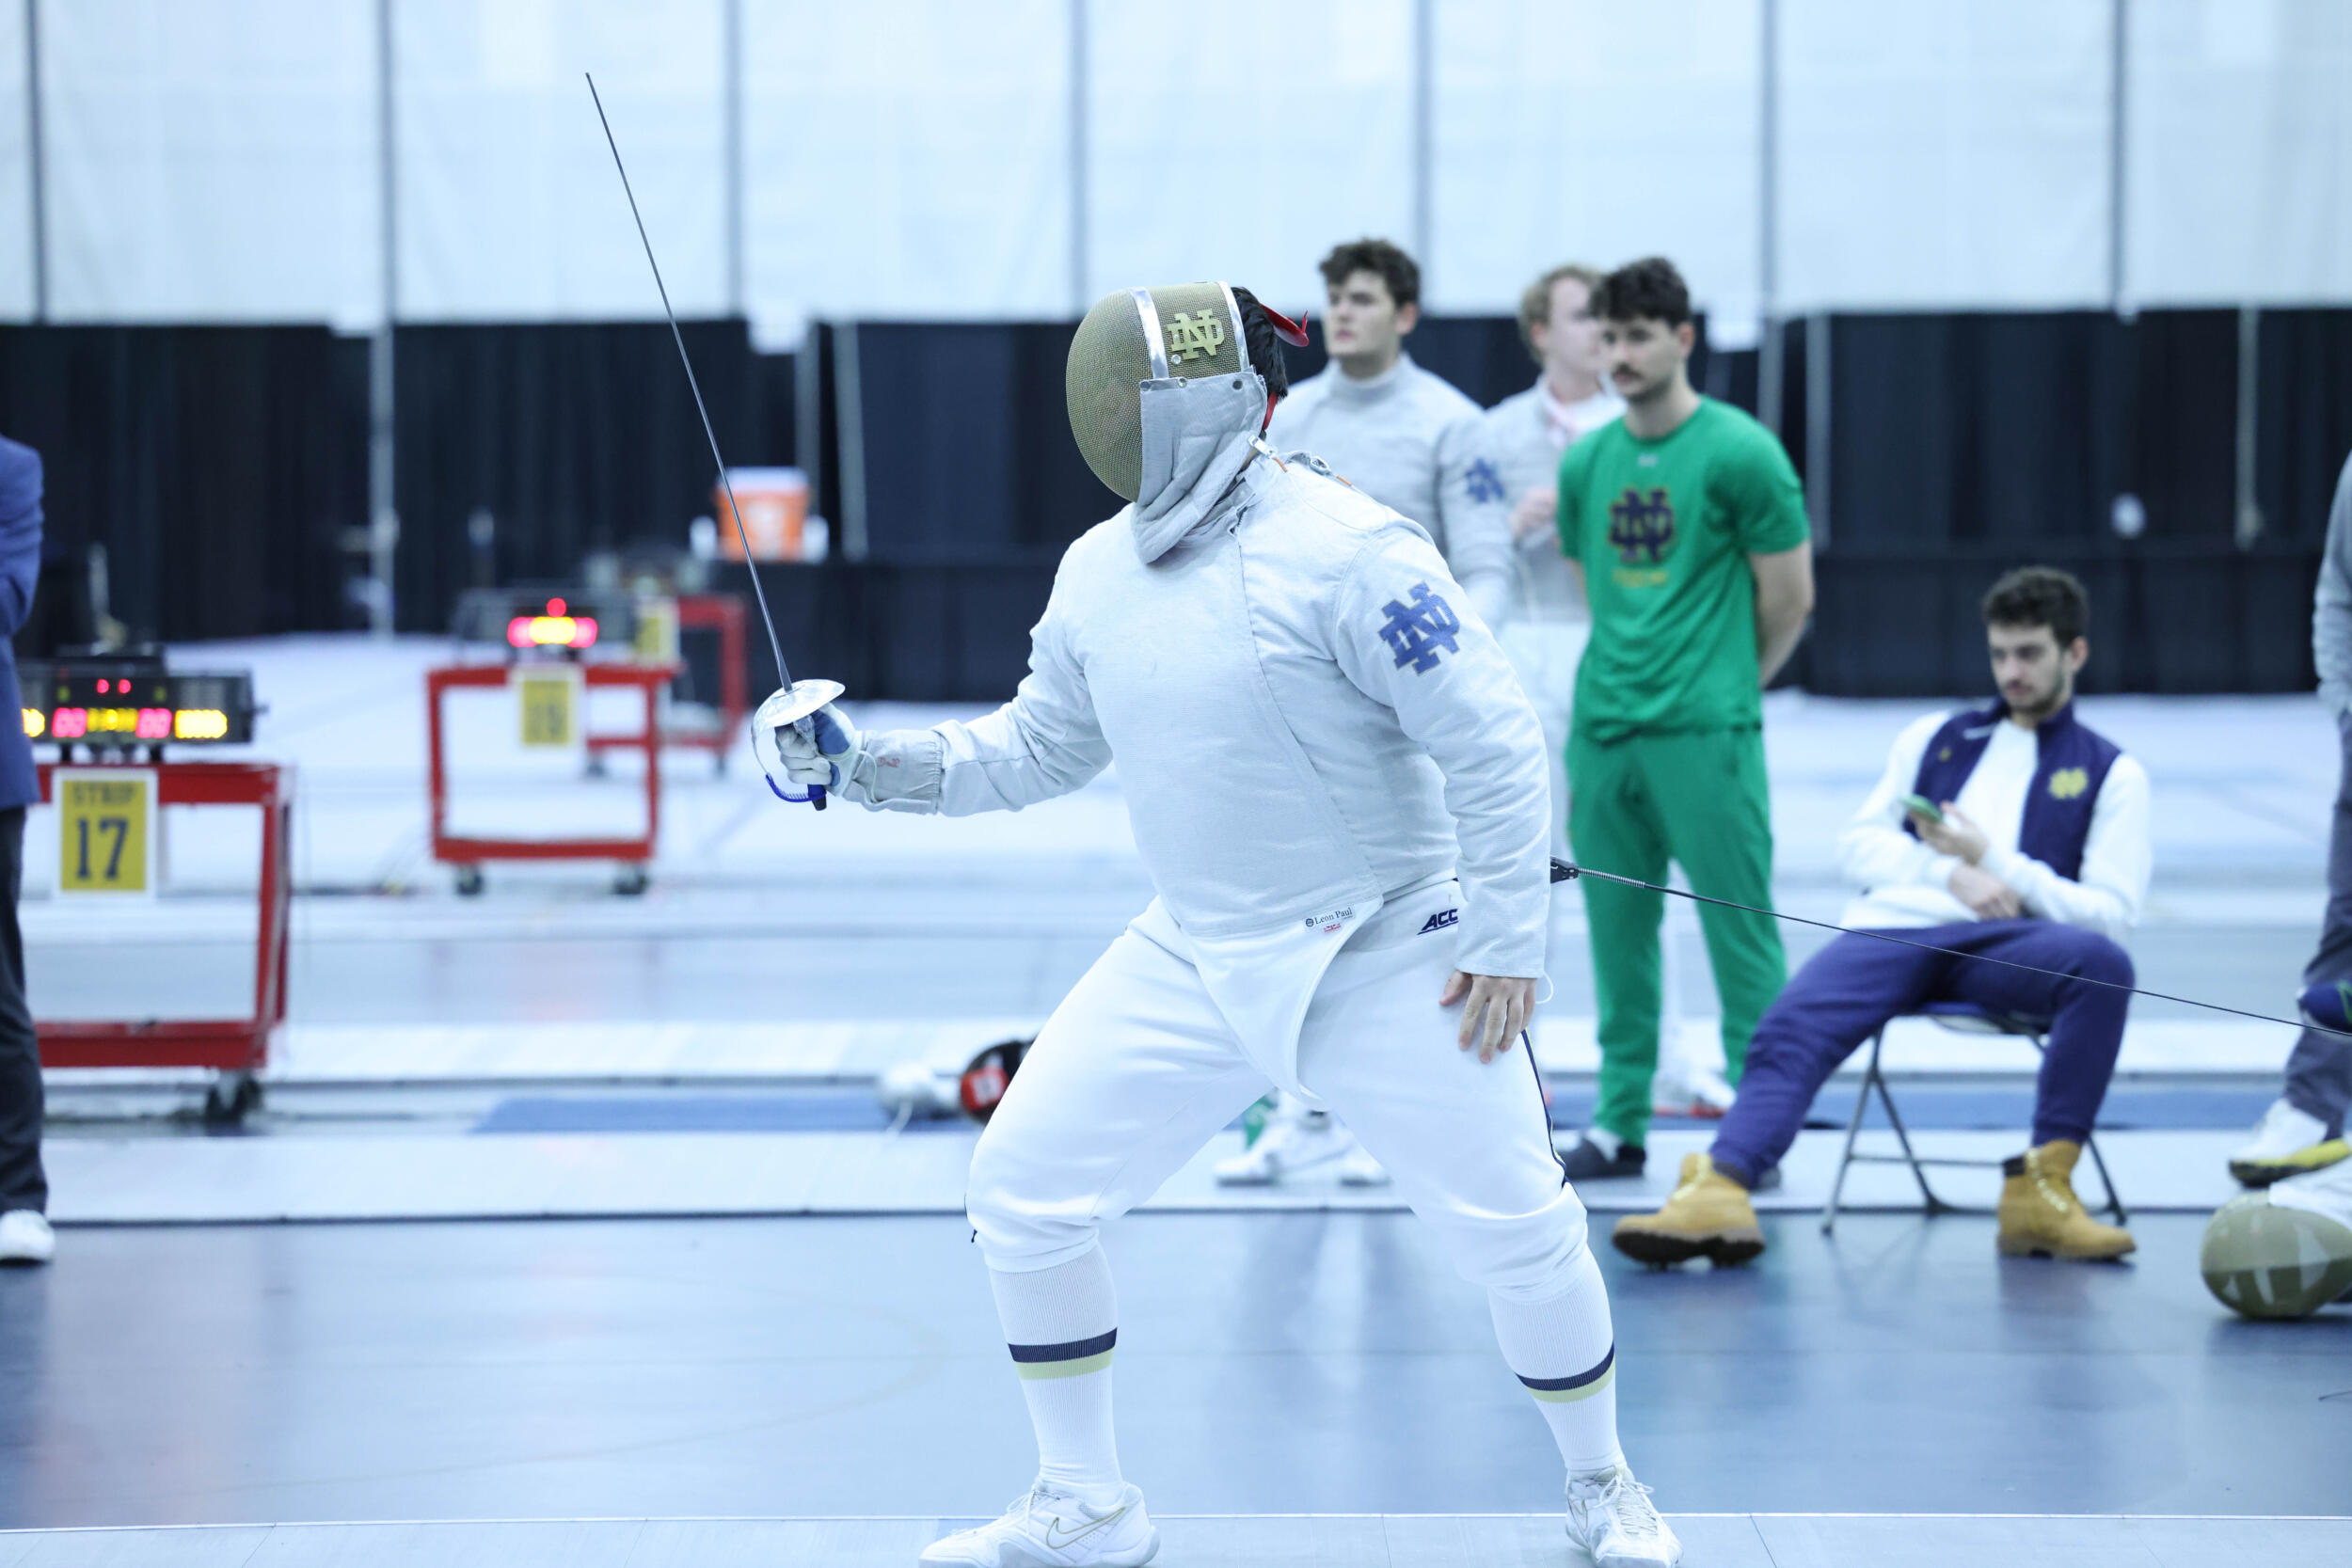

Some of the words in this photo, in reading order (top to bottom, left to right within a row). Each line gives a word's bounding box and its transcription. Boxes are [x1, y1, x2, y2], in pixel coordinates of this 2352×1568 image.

[75, 816, 129, 881] 17
[1314, 914, 1334, 925] Leon
[1335, 907, 1353, 919] Paul
[1421, 908, 1458, 931] ACC
